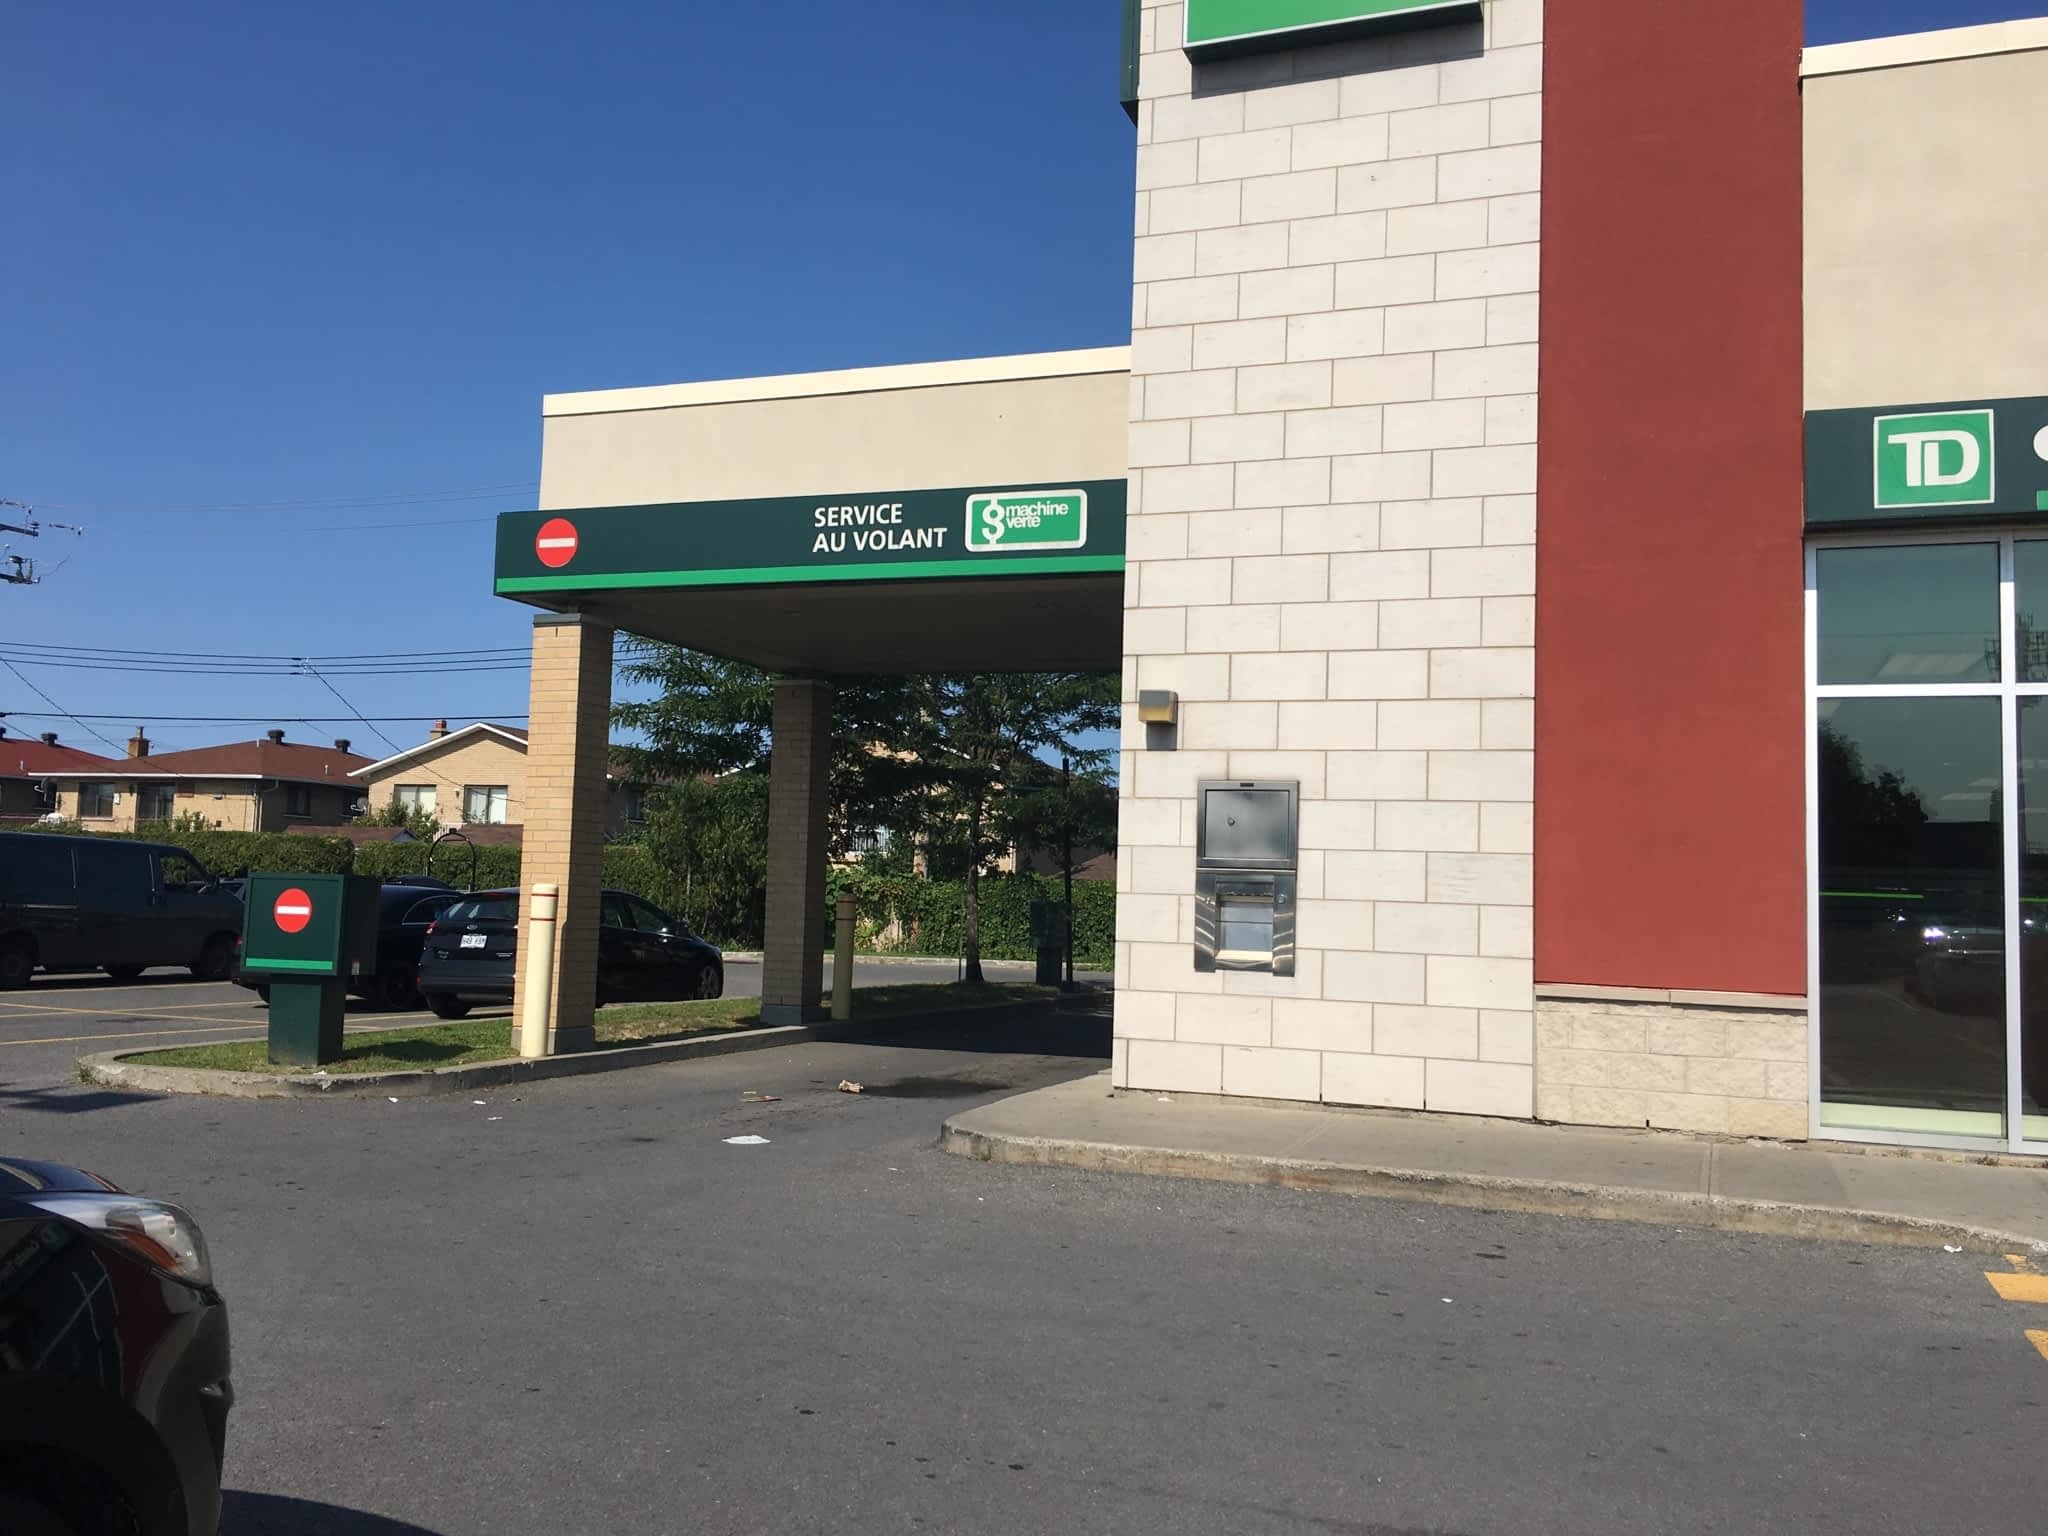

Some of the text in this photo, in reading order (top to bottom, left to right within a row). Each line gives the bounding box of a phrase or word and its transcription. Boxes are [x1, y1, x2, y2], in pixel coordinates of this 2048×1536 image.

[1887, 429, 1981, 488] TD
[813, 503, 903, 528] SERVICE
[1006, 500, 1069, 517] machine
[1006, 515, 1041, 529] verte
[811, 527, 948, 553] AU VOLANT
